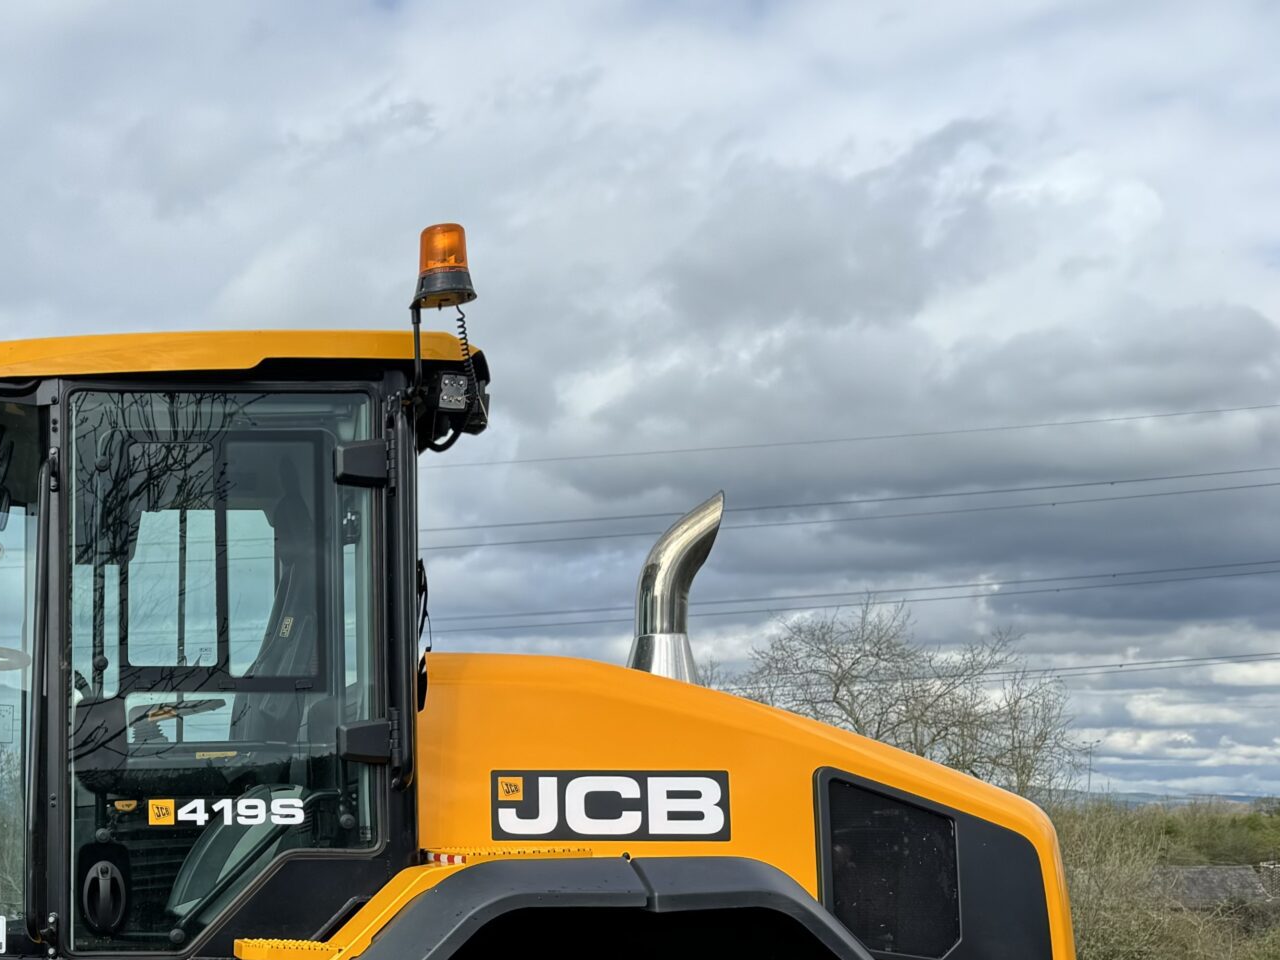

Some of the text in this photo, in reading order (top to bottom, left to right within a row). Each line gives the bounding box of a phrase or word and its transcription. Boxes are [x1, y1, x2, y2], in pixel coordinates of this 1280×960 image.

[501, 781, 520, 796] JCB
[154, 805, 171, 820] JCB
[177, 799, 305, 825] 419S
[497, 776, 725, 834] JCB
